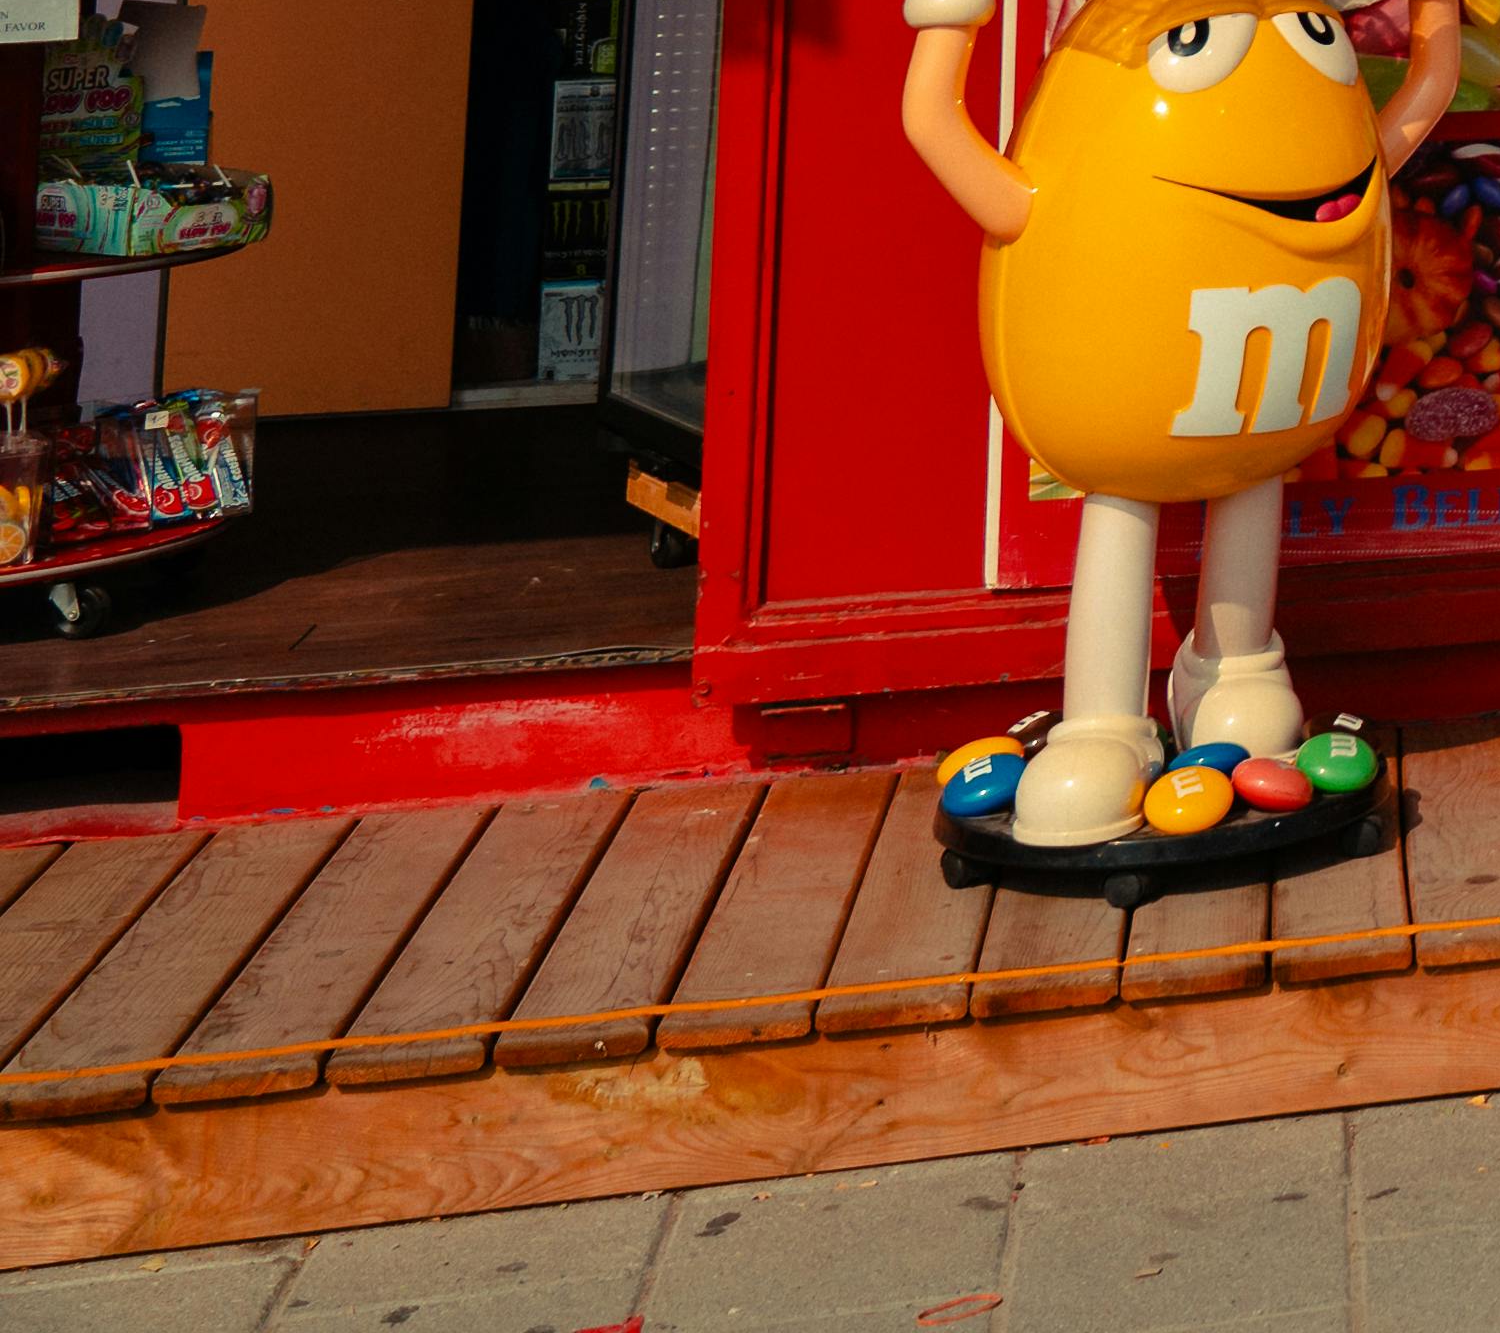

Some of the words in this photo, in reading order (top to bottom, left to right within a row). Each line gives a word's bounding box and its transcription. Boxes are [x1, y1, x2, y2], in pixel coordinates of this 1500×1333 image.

[5, 21, 46, 33] FAVOR
[47, 65, 109, 91] SUPER
[41, 92, 81, 114] LOW
[87, 85, 132, 110] POP
[1171, 276, 1364, 439] m
